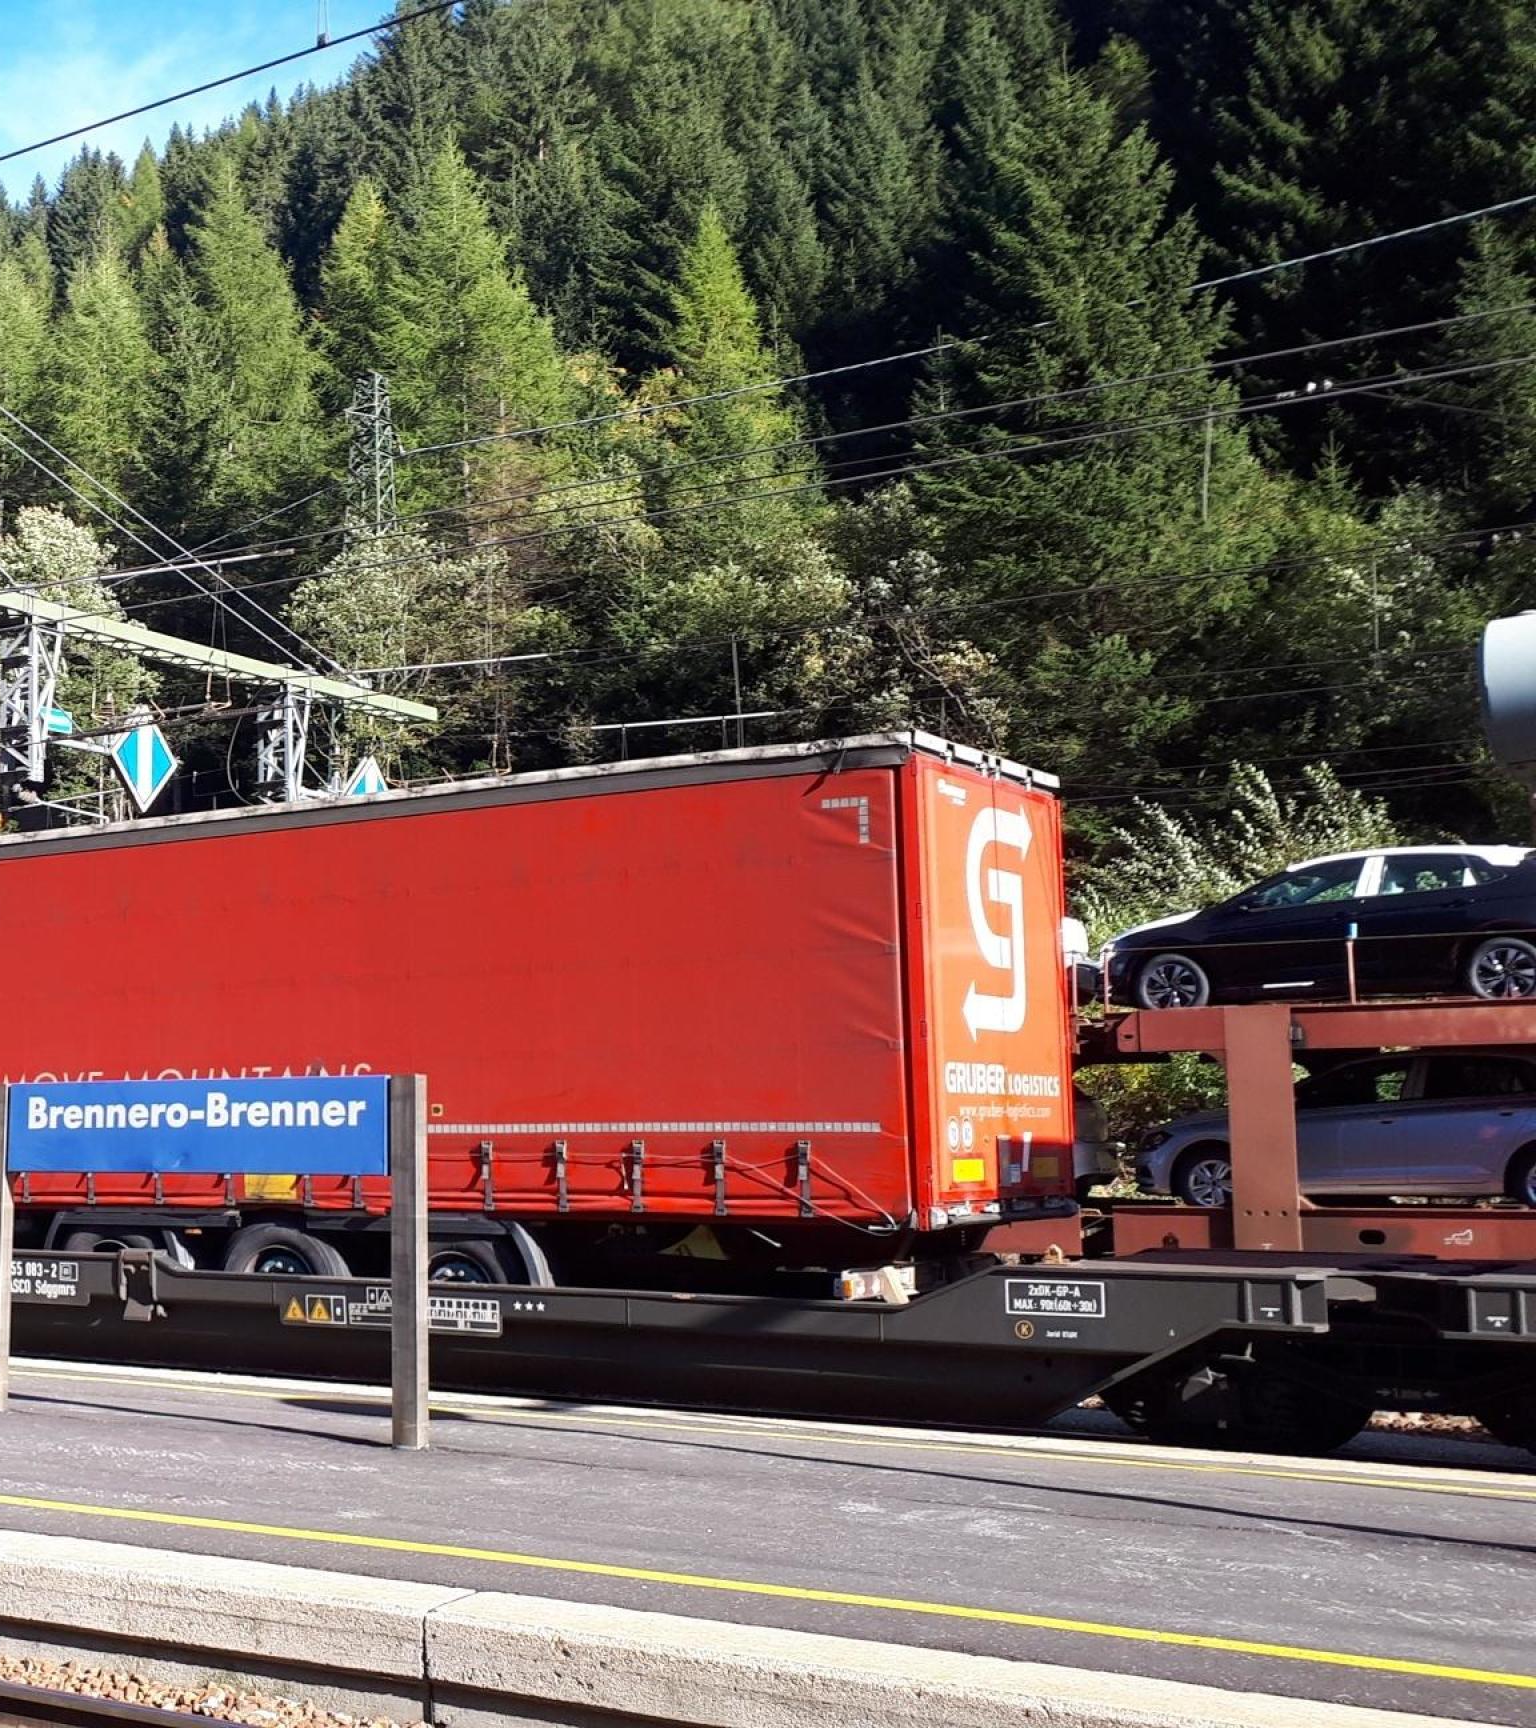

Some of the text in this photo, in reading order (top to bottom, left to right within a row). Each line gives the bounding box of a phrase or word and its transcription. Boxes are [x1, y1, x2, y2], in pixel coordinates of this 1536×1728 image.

[945, 1062, 1059, 1097] GRUBER LOGISTICS
[28, 1092, 367, 1129] Brennero-Brenner
